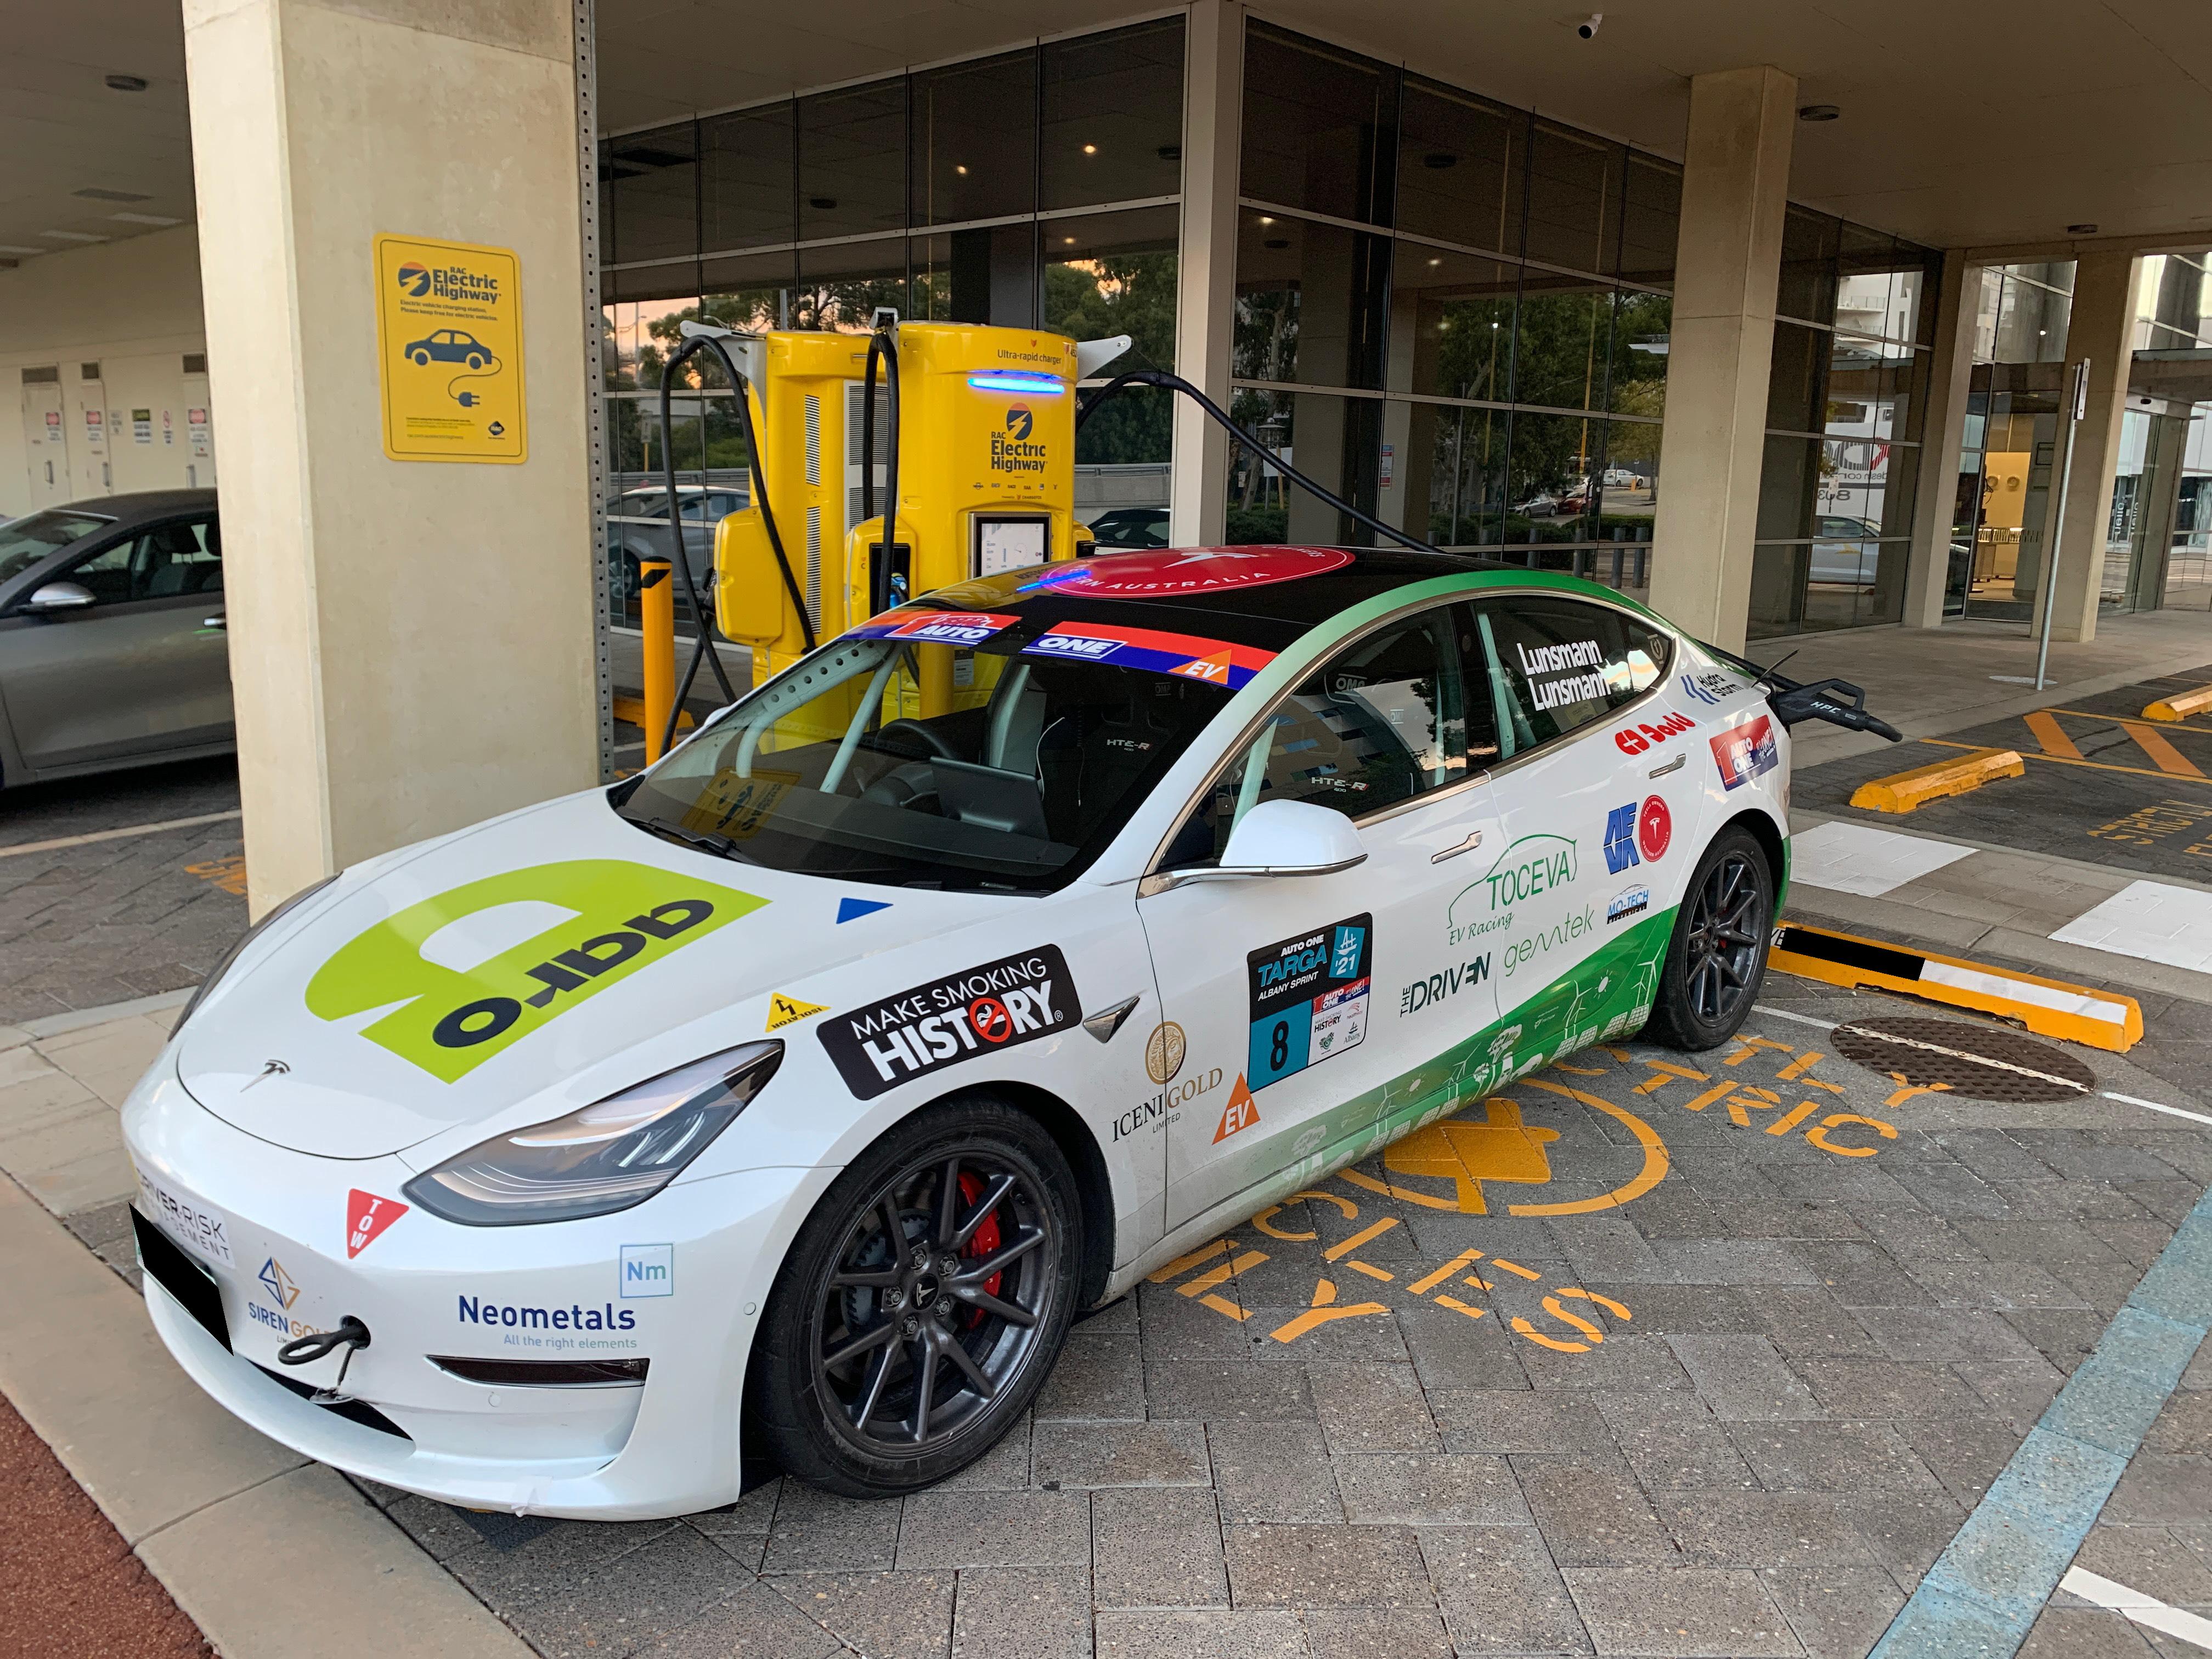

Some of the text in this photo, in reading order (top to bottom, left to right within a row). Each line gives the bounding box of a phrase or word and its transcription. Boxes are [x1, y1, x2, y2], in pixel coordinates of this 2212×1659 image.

[433, 269, 498, 289] Electric
[433, 284, 498, 304] Highway
[997, 349, 1062, 365] Ultra-rapid charger
[991, 431, 1006, 439] RAC
[991, 440, 1046, 456] Electric
[991, 456, 1046, 473] Highway
[1105, 573, 1272, 590] AUSTRALIA
[912, 625, 1115, 654] AUTO ONE
[1517, 639, 1603, 676] Lunsmann
[1184, 661, 1226, 678] EV
[1527, 672, 1612, 711] Lunsmann
[1810, 701, 1841, 714] HPC
[1107, 738, 1152, 751] HTE-R
[1731, 737, 1753, 760] AUTO
[1734, 752, 1754, 773] ONE
[1311, 777, 1369, 791] HTE-R
[1486, 850, 1570, 911] TOCEVA
[1607, 889, 1649, 917] MO-TECH
[1449, 912, 1515, 946] EV Racing
[1280, 934, 1324, 957] AUTO ONE
[1257, 944, 1328, 988] TARGA
[1257, 971, 1319, 1002] ALBANY SPRINT
[1323, 988, 1345, 1001] AUTO
[1400, 951, 1491, 1018] THE DRIVEN
[851, 958, 1046, 1040] MAKE SMOKING
[1322, 997, 1339, 1009] ONE
[771, 1007, 822, 1029] ISOLATOR
[1269, 1020, 1290, 1072] 8
[1224, 1099, 1250, 1135] EV
[350, 1198, 383, 1249] TOW
[627, 1261, 667, 1281] Nm
[459, 1295, 636, 1330] Neometals
[504, 1334, 637, 1350] All the right elements
